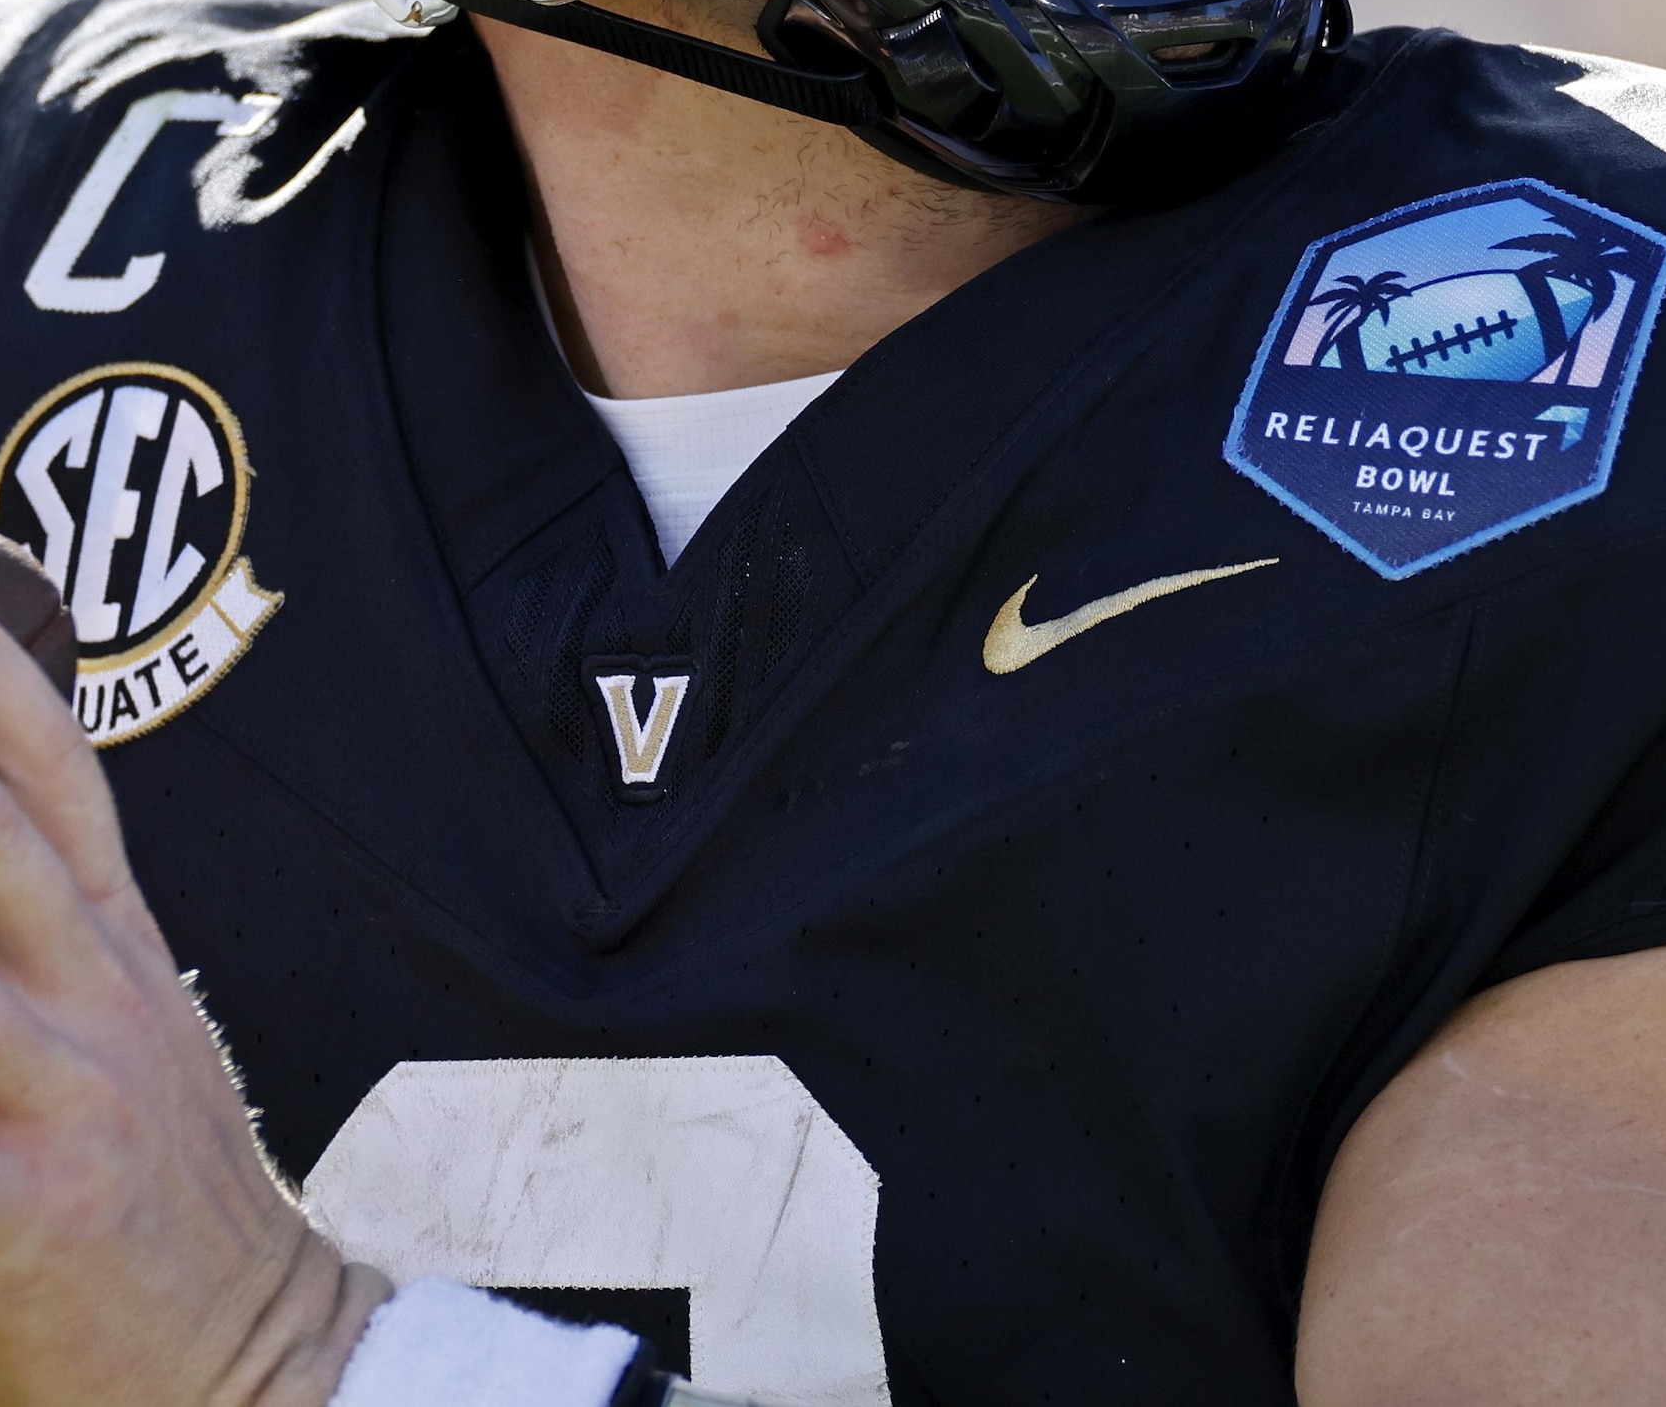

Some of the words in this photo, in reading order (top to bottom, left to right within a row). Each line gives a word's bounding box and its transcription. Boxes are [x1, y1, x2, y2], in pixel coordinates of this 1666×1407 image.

[24, 90, 284, 313] C
[1265, 412, 1547, 461] RELIAQUEST
[1356, 465, 1455, 496] BOWL
[15, 385, 224, 643] SEC
[1353, 502, 1411, 517] TAMPA
[1422, 509, 1455, 521] BAY
[77, 634, 210, 734] UATE
[596, 674, 690, 784] V
